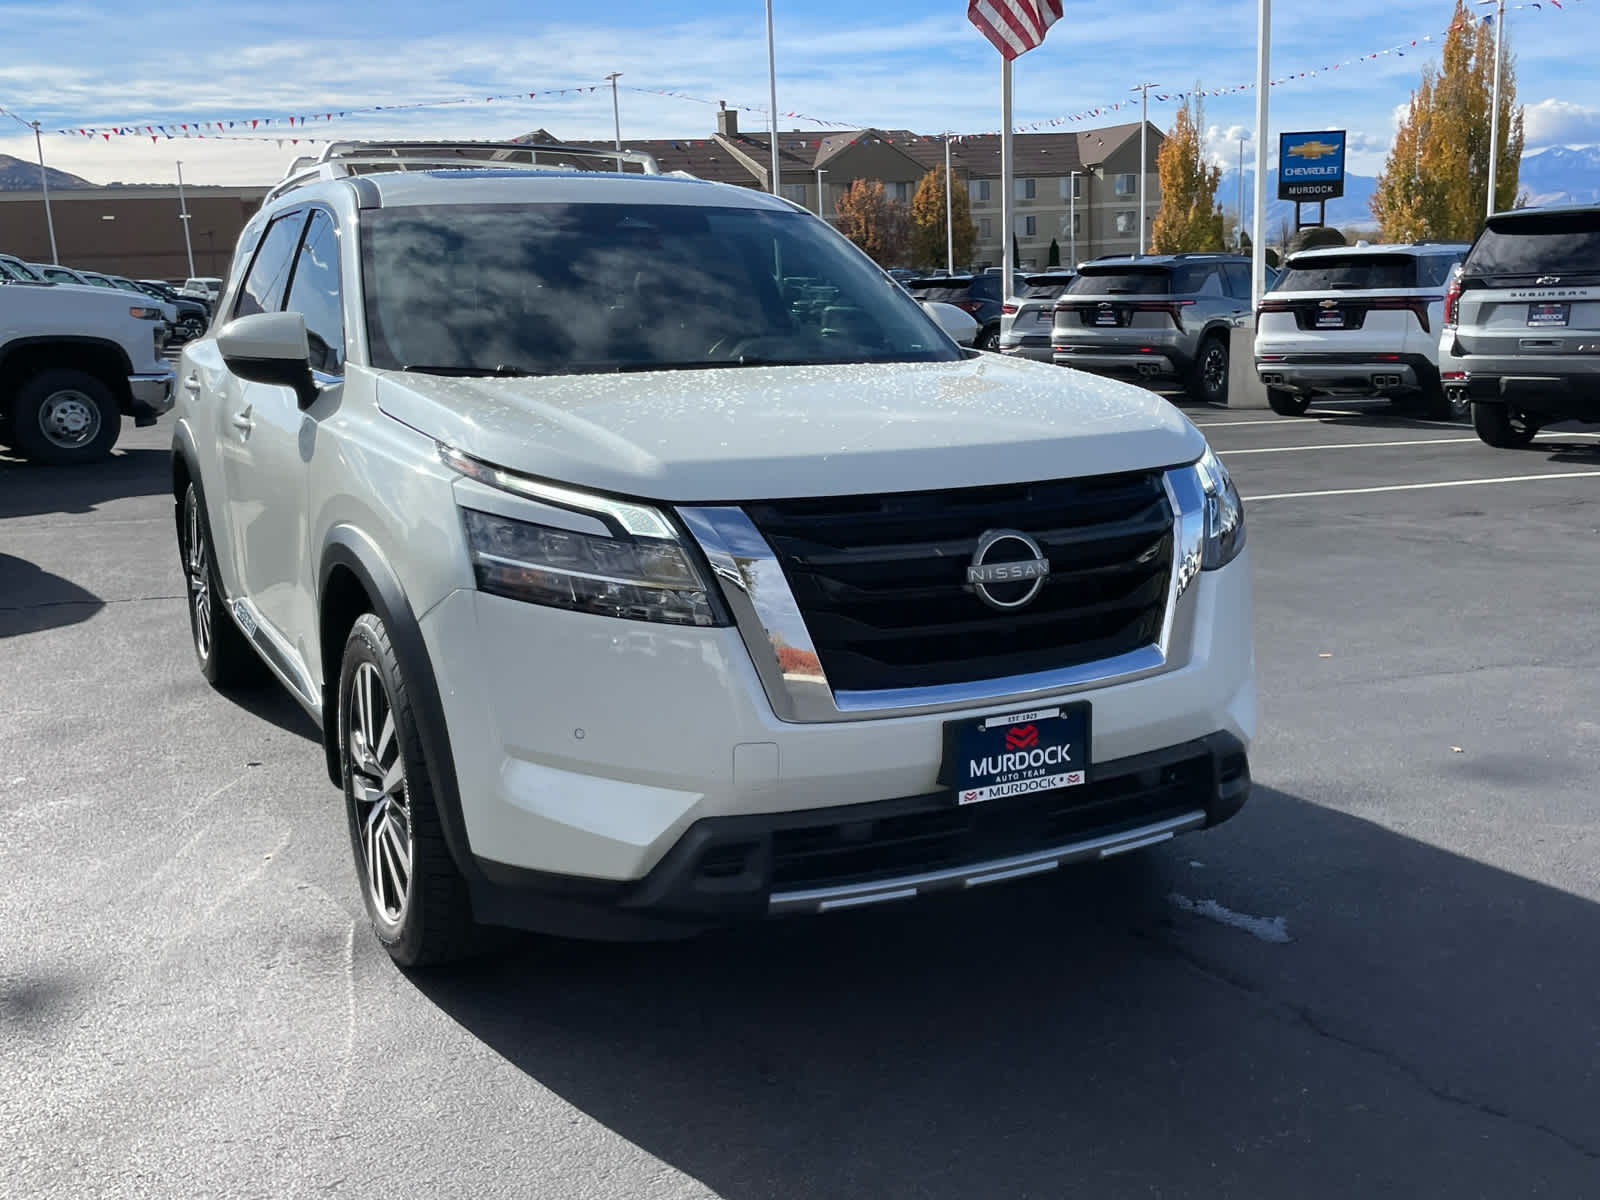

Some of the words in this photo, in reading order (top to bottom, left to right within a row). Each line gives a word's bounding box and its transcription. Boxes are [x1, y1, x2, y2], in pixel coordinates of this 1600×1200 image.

[1284, 166, 1338, 176] CHEVROLET
[1288, 185, 1333, 194] MURDOCK
[970, 562, 1048, 581] NISSAN
[970, 743, 1071, 778] MURDOCK
[995, 774, 1020, 783] AUTO
[1023, 768, 1046, 779] TEAM
[989, 776, 1056, 798] MURDOCK
